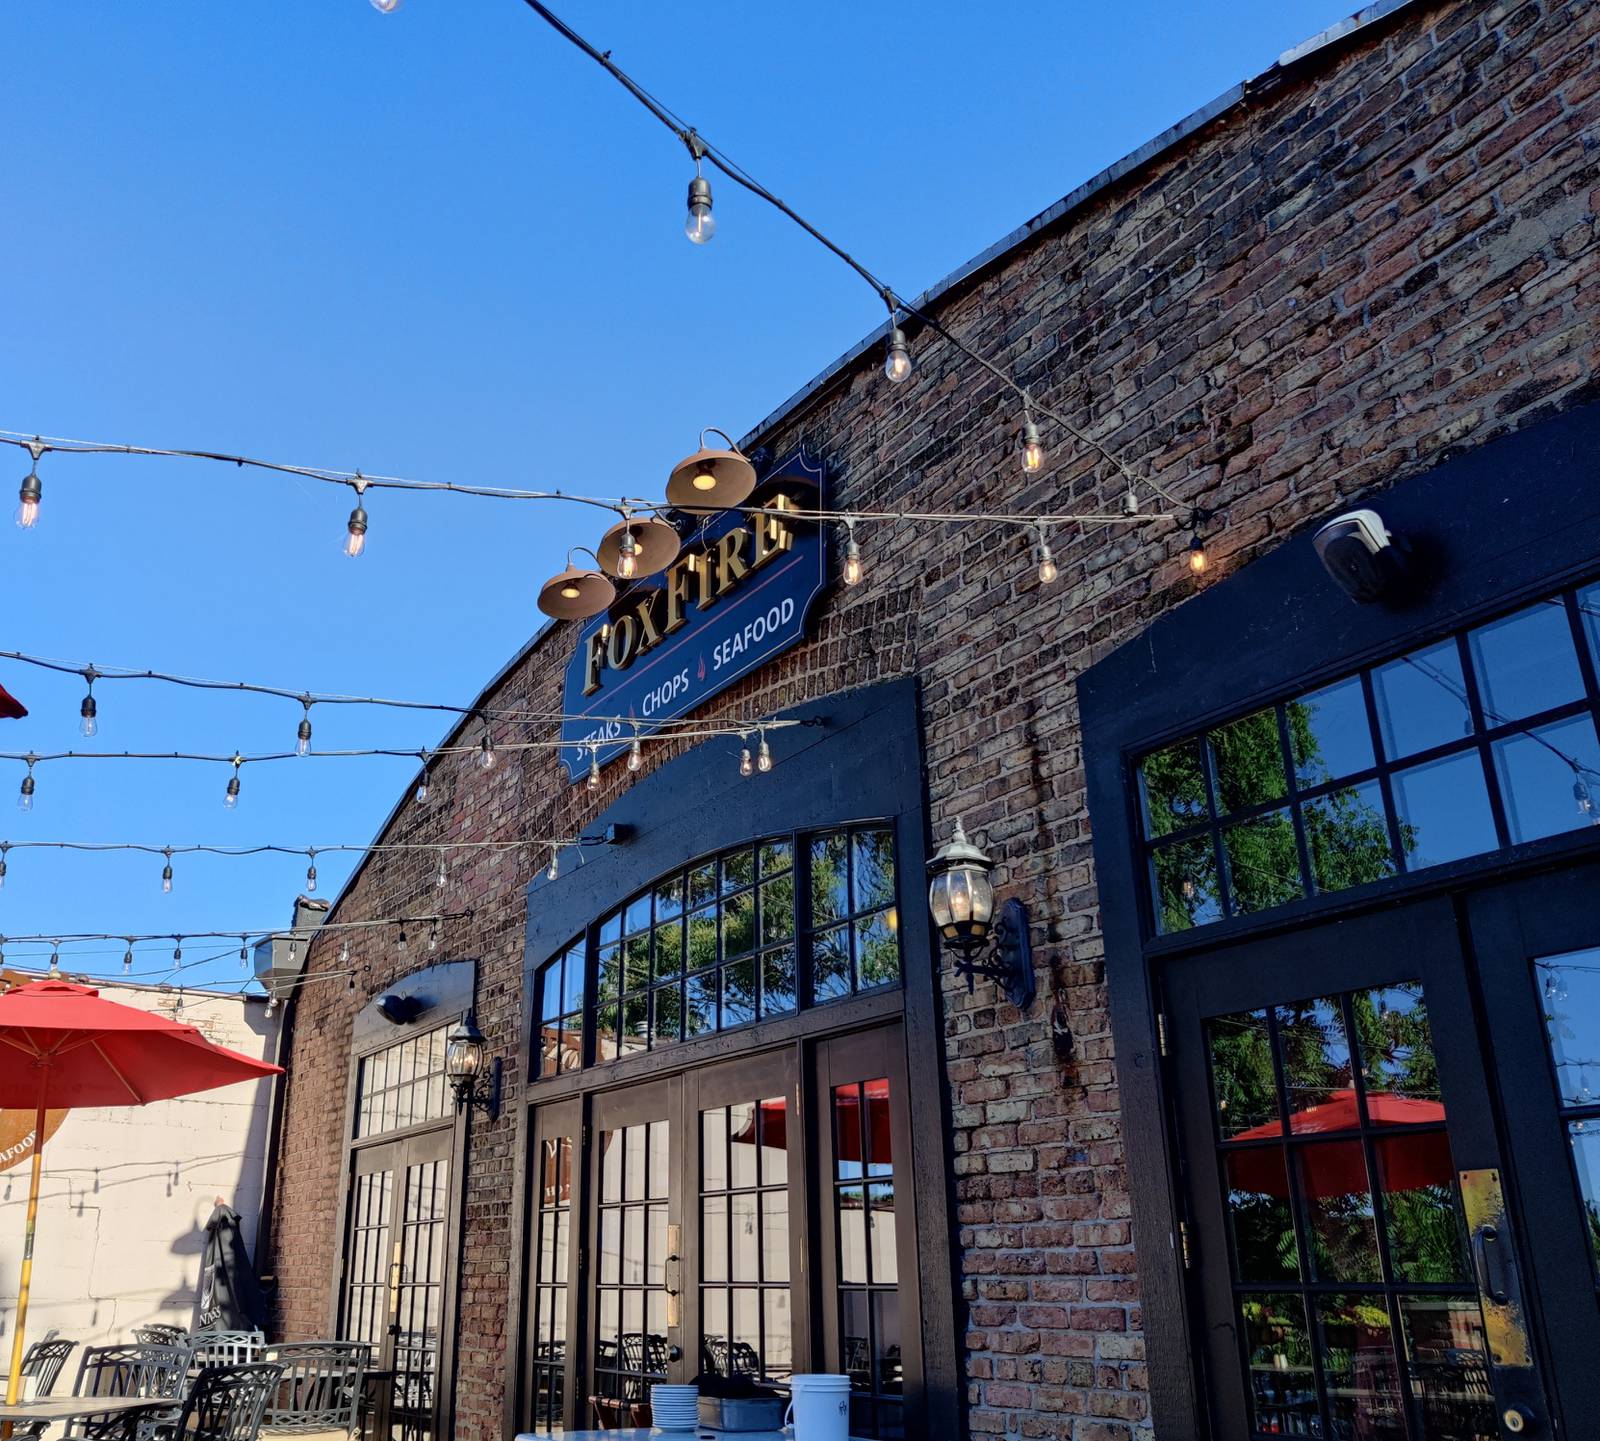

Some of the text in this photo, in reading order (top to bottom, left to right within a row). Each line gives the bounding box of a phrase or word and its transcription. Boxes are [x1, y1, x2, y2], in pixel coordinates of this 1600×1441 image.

[577, 598, 795, 761] STEAKS CHOPS SEAFOOD
[581, 494, 793, 696] FOXFIRE
